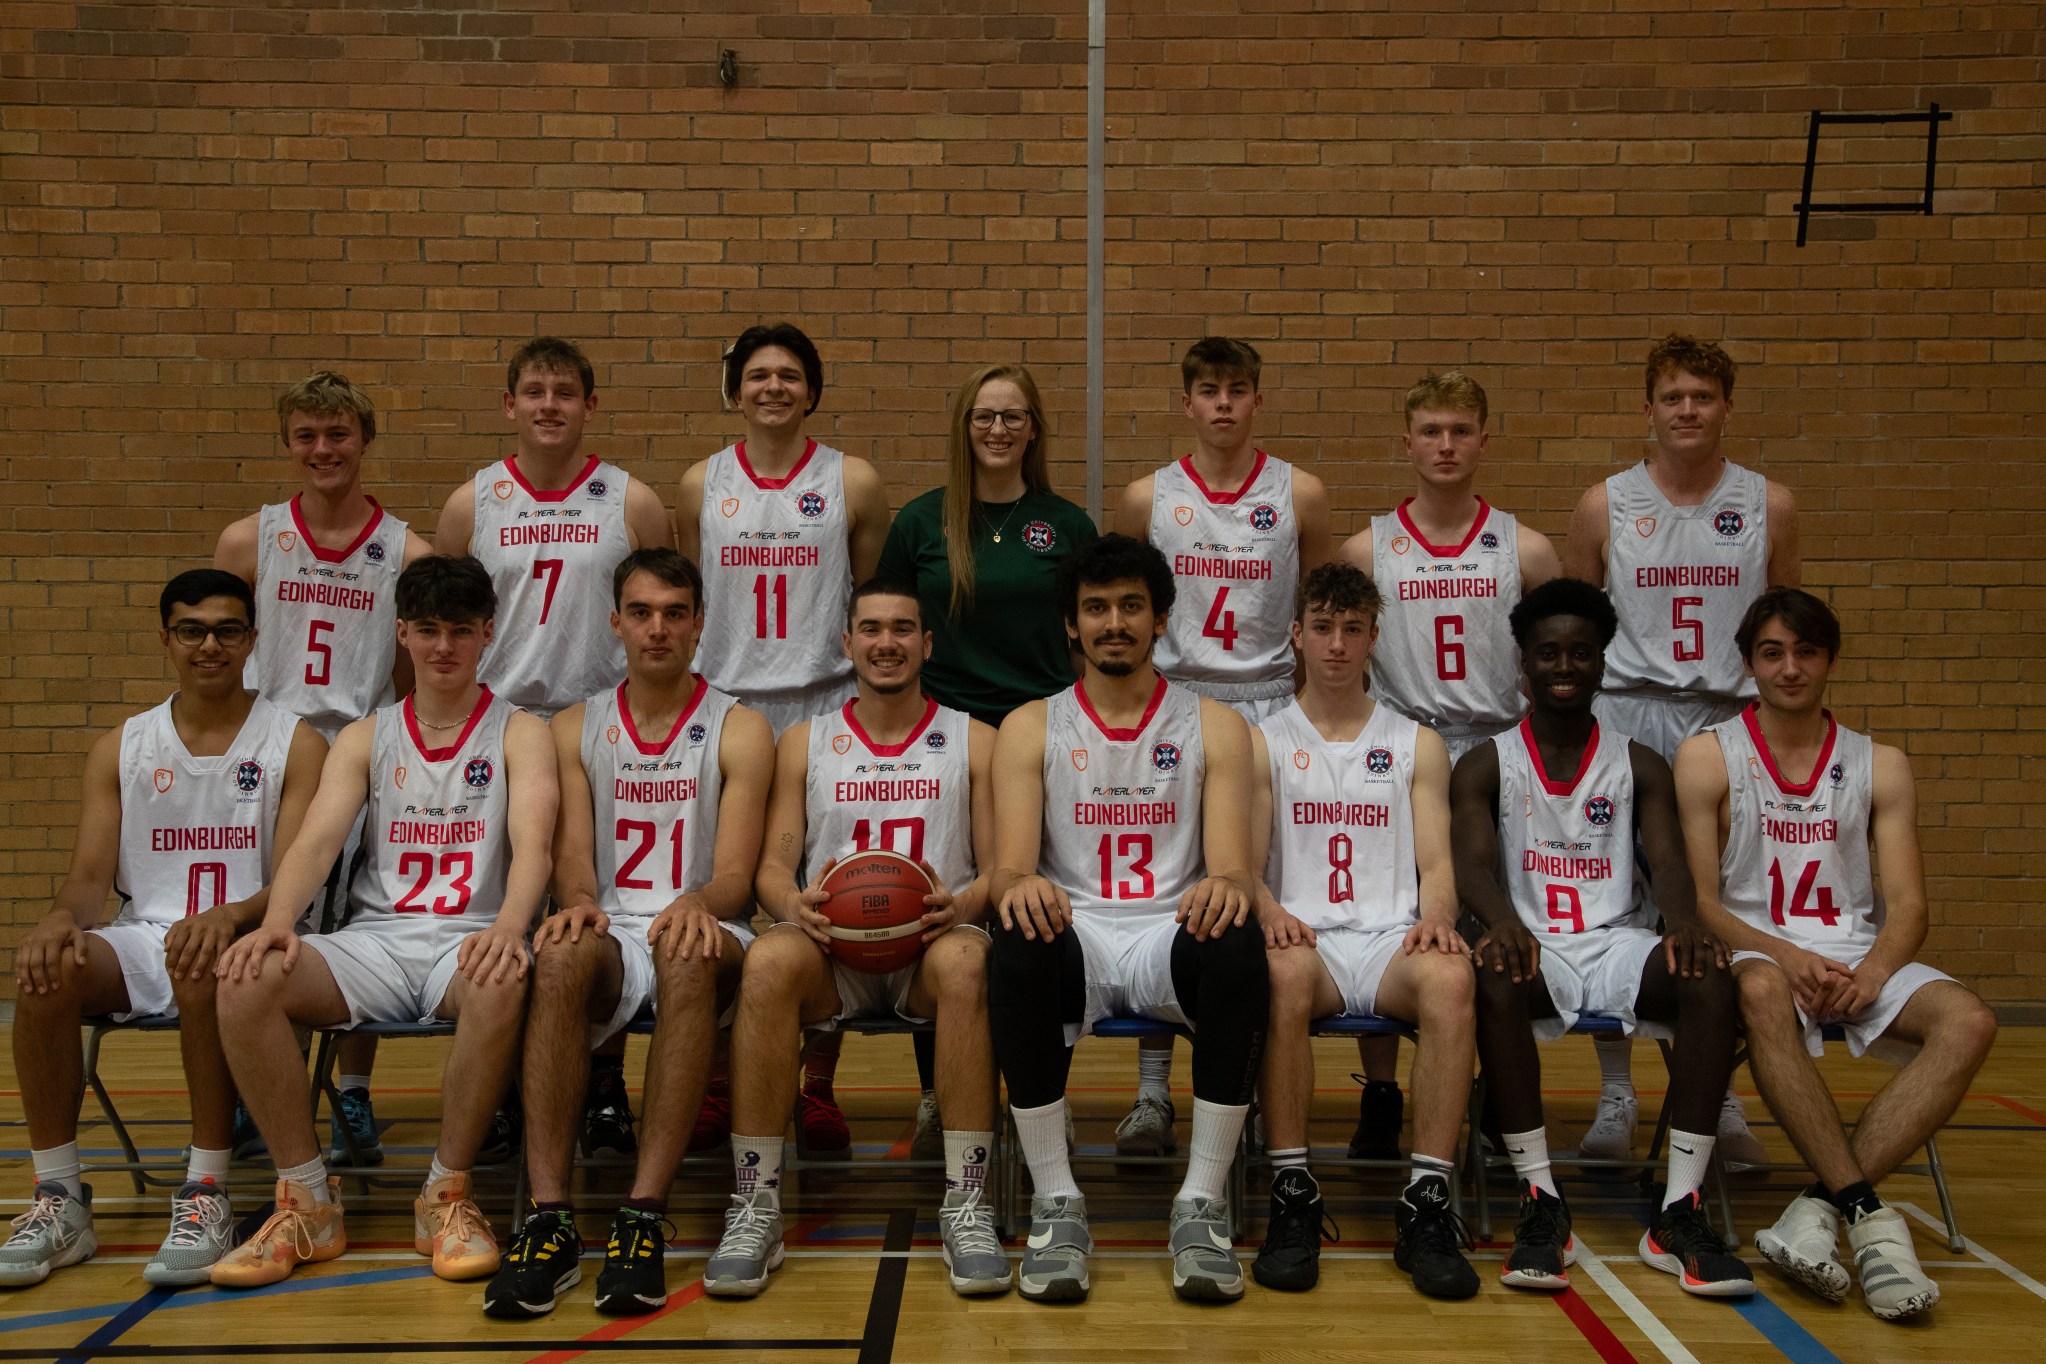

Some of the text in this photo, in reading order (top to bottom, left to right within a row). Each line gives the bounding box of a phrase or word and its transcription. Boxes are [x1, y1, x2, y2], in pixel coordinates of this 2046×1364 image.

[518, 509, 581, 519] PLAYERLAYER
[500, 524, 598, 546] EDINBURGH
[739, 531, 800, 540] PLAYERLAYER
[1193, 542, 1254, 553] PLAYERLAYER
[721, 546, 818, 566] EDINBURGH
[1174, 554, 1271, 580] EDINBURGH
[1416, 563, 1478, 573] PLAYERLAYER
[298, 567, 358, 581] PLAYERLAYER
[1636, 566, 1739, 588] EDINBURGH
[278, 581, 374, 611] EDINBURGH
[533, 560, 563, 625] 7
[1399, 578, 1496, 601] EDINBURGH
[753, 574, 786, 639] 11
[1202, 586, 1238, 651] 4
[1673, 597, 1703, 662] 5
[305, 620, 335, 686] 5
[1434, 615, 1466, 681] 6
[856, 763, 921, 773] PLAYERLAYER
[615, 777, 697, 803] DINBURGH
[835, 779, 940, 803] EDINBURGH
[1092, 787, 1155, 796] PLAYERLAYER
[405, 805, 468, 816] PLAYERLAYER
[1075, 801, 1176, 826] EDINBURGH
[1293, 801, 1388, 827] EDINBURGH
[152, 826, 256, 851] EDINBURGH
[389, 820, 485, 845] EDINBURGH
[615, 818, 685, 890] 21
[1098, 833, 1155, 900] 13
[845, 863, 901, 880] molten
[1329, 832, 1354, 903] 8
[394, 852, 473, 916] 23
[1767, 856, 1841, 926] 14
[862, 894, 889, 909] FIBA
[1546, 883, 1585, 933] 9
[864, 930, 890, 939] BG4500
